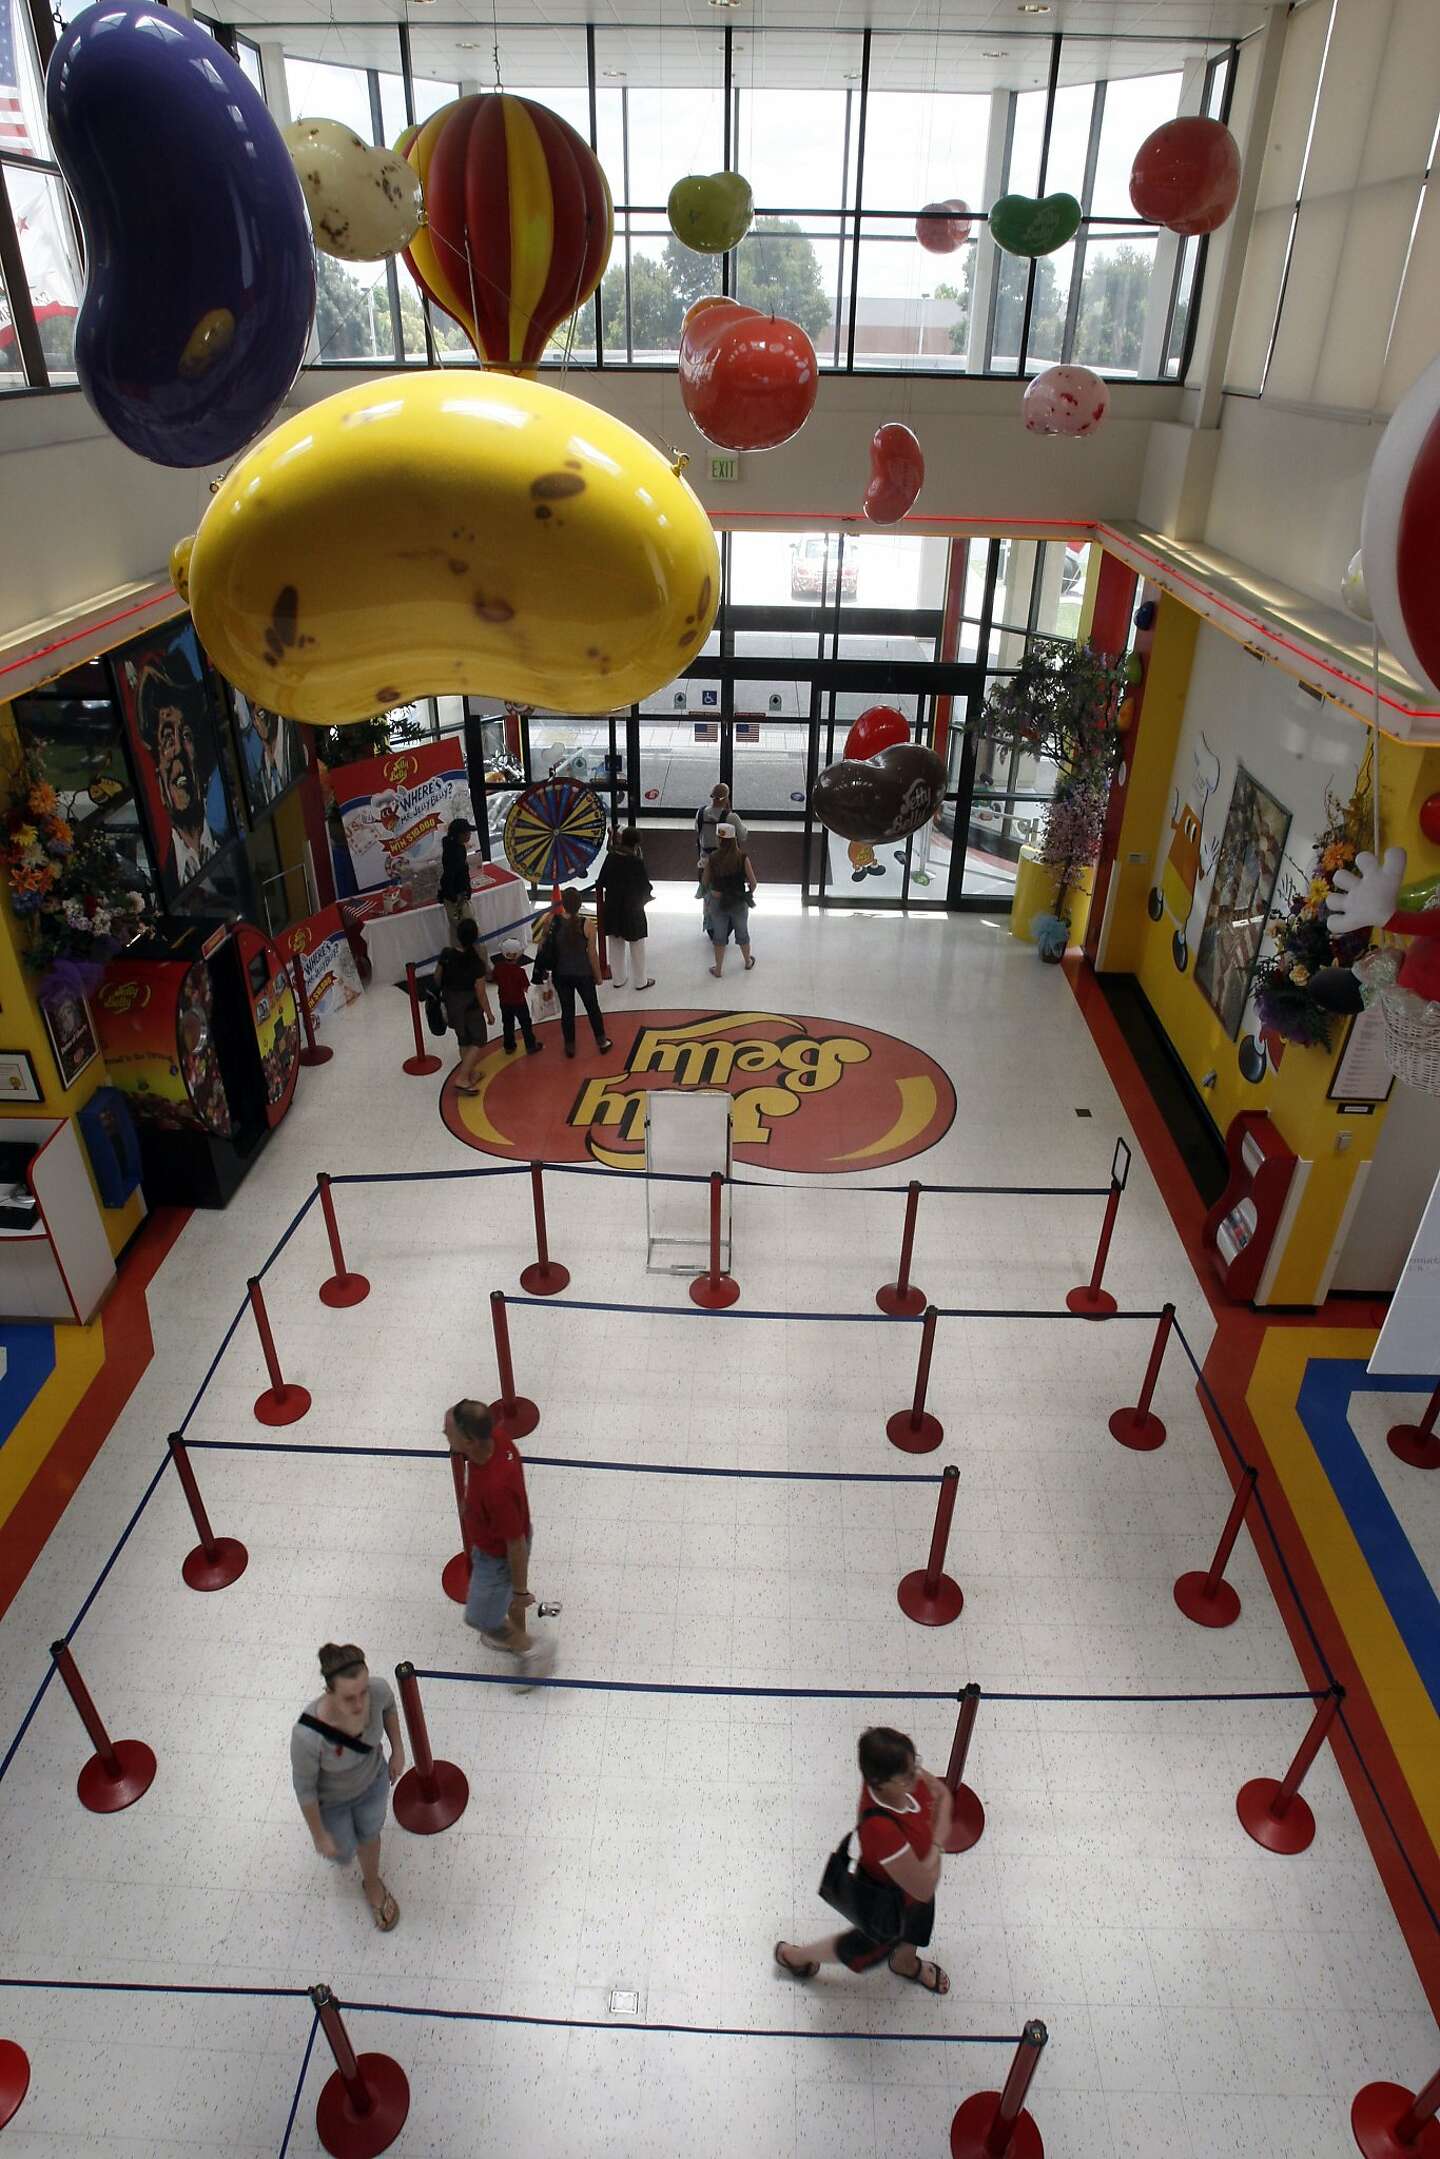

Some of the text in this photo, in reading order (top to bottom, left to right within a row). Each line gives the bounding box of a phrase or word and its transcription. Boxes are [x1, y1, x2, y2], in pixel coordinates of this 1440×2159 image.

[711, 460, 735, 478] EXIT
[400, 779, 442, 812] WHERE'S
[389, 818, 436, 853] WIN $10,000
[625, 1012, 872, 1094] Belly
[568, 1072, 801, 1171] Jly
